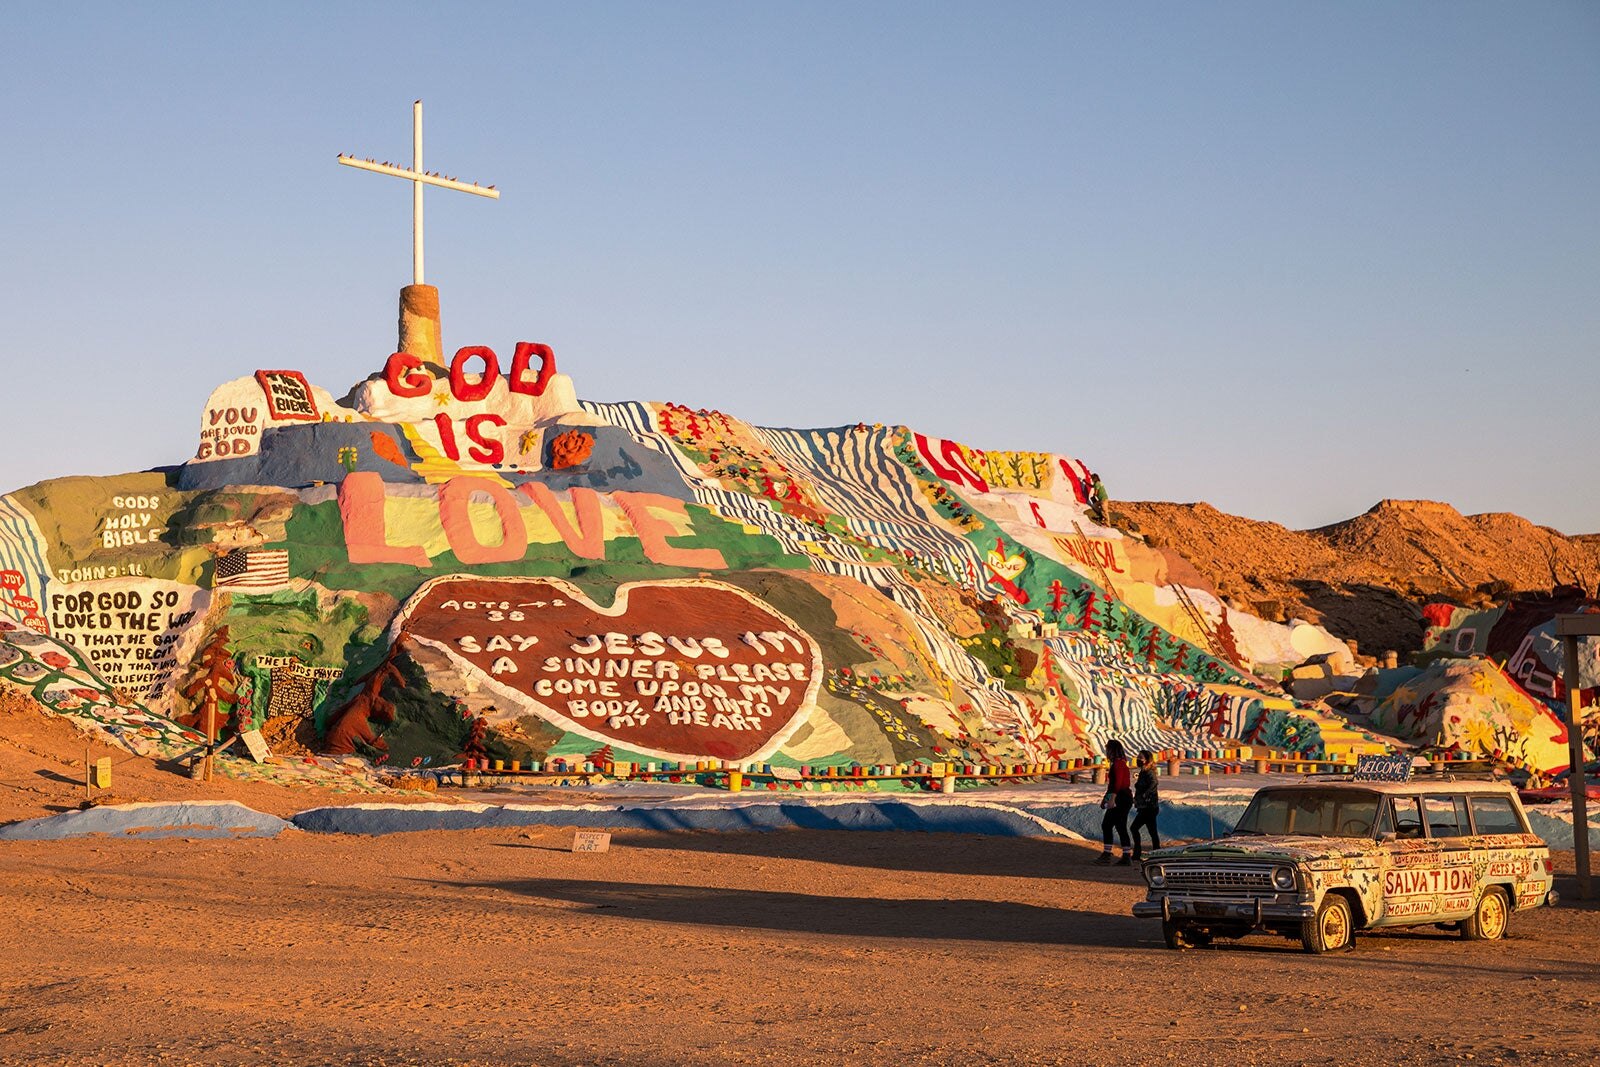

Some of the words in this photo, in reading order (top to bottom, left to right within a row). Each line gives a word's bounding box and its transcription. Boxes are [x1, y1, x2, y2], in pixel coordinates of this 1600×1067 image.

[386, 342, 557, 402] GOD
[210, 407, 257, 426] YOU
[434, 412, 507, 464] IS
[199, 439, 251, 459] GOD
[112, 496, 160, 510] GODS
[105, 513, 151, 529] HOLY
[338, 471, 729, 569] LOVE
[103, 528, 161, 548] BIBLE
[990, 556, 1020, 571] LOVE
[4, 574, 20, 584] JOY
[58, 565, 106, 584] JOHN
[52, 591, 94, 613] FOR
[97, 591, 142, 610] GOD
[150, 590, 179, 610] SO
[52, 612, 112, 629] LOVED
[117, 612, 161, 631] THE
[487, 610, 525, 622] 38
[82, 634, 123, 646] THAT
[127, 634, 147, 645] HE
[458, 634, 539, 653] SAY
[570, 631, 730, 658] JESUS
[90, 648, 131, 660] ONLY
[258, 656, 279, 666] THE
[94, 662, 122, 673] SON
[128, 662, 157, 671] THAT
[491, 656, 518, 674] A
[541, 656, 680, 680] SINNER
[695, 662, 810, 682] PLEASE
[130, 684, 152, 693] NOT
[534, 678, 621, 697] COME
[636, 680, 727, 698] UPON
[738, 683, 791, 705] MY
[653, 695, 707, 713] AND
[711, 697, 773, 717] INTO
[609, 709, 650, 729] MY
[668, 710, 762, 730] HEART
[1357, 760, 1407, 775] WELCOME
[578, 843, 599, 851] ART
[1491, 862, 1509, 874] ACTS
[1386, 870, 1472, 894] SALVATION
[1388, 902, 1430, 914] MOUNTAIN
